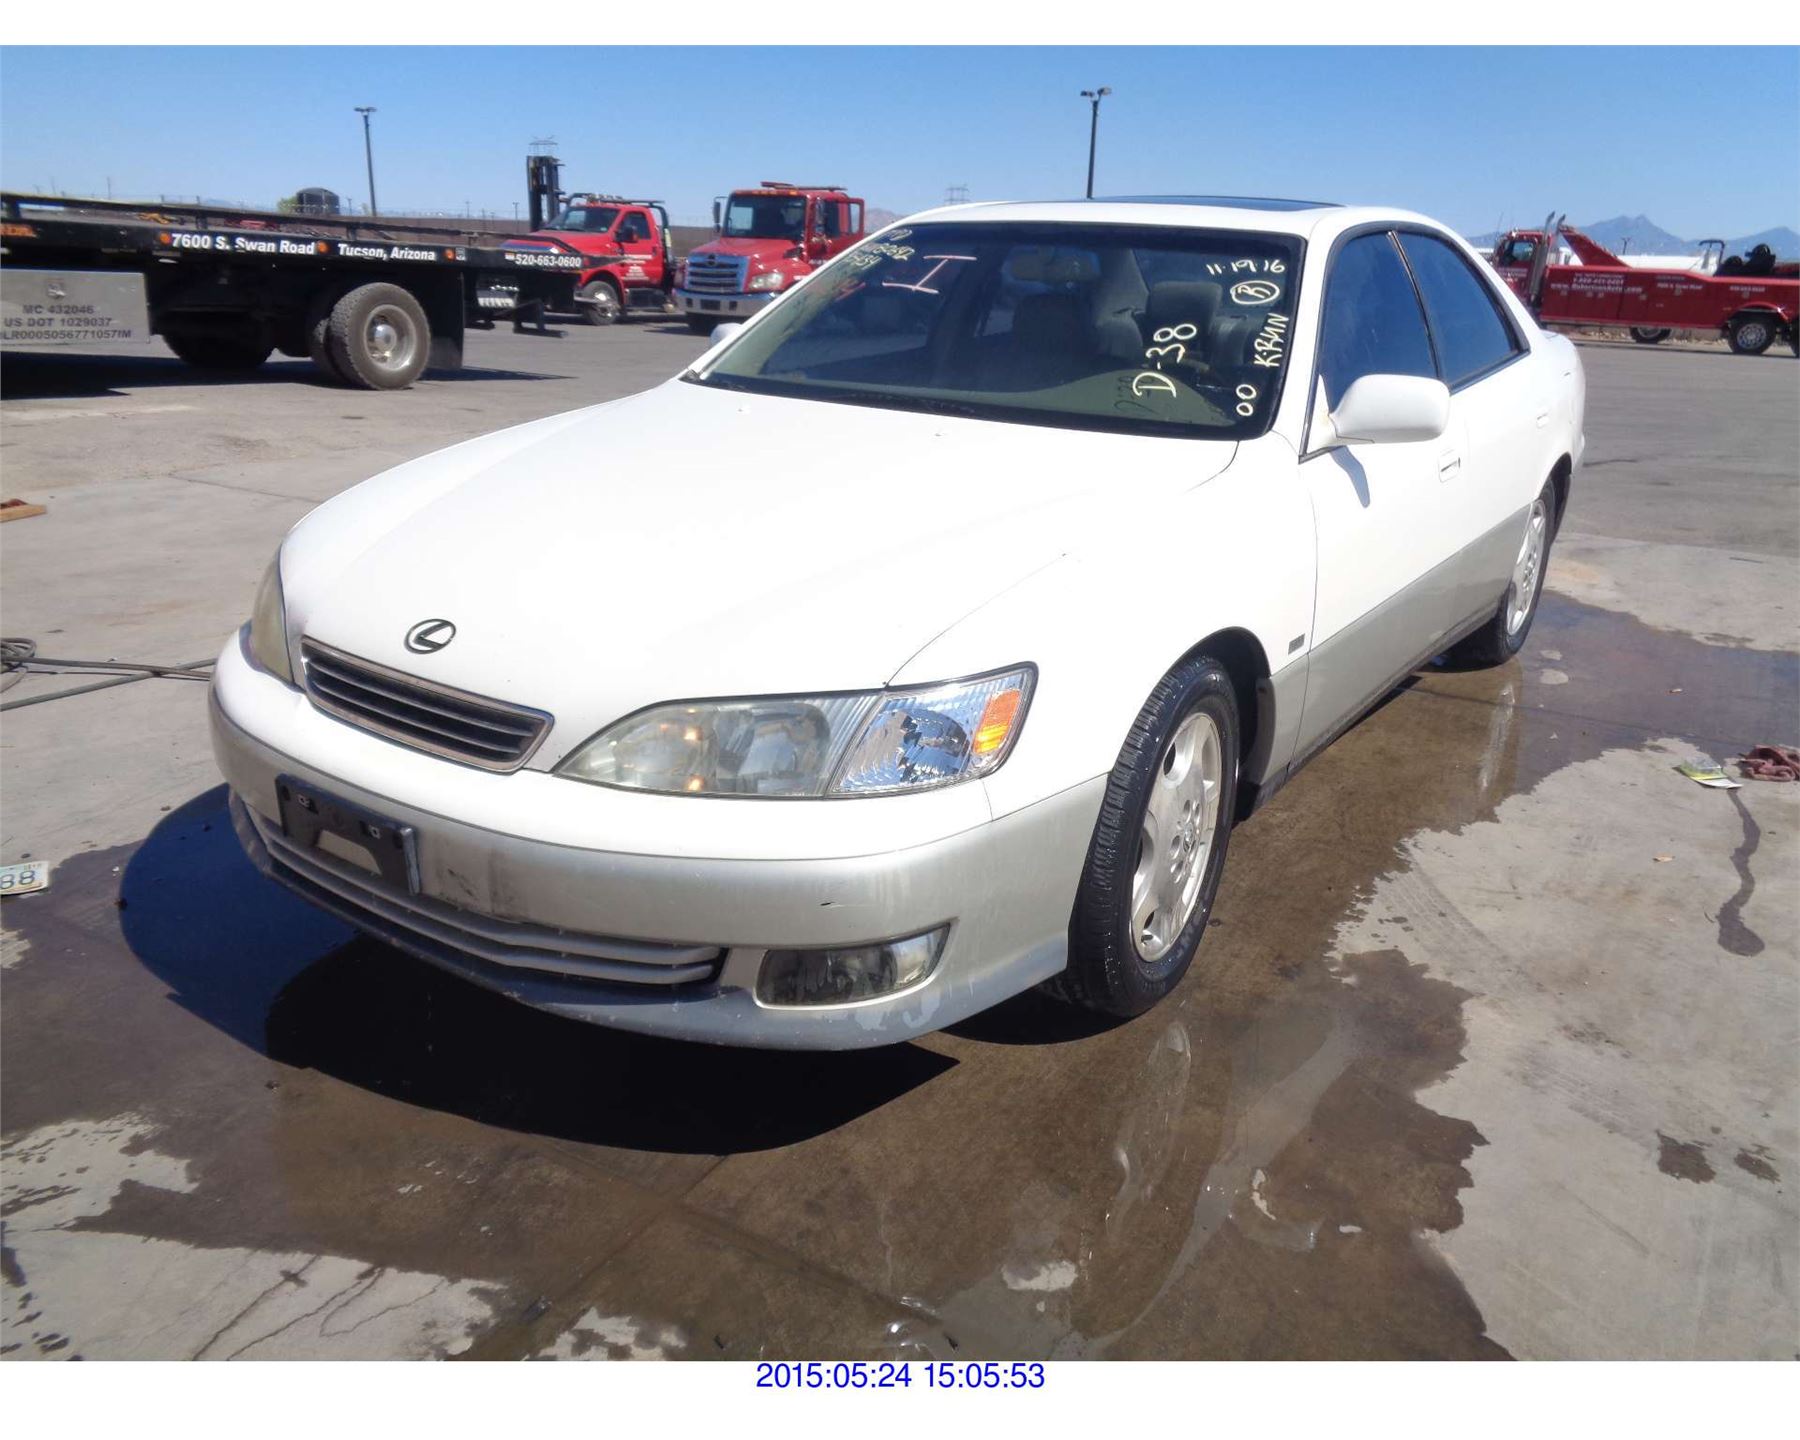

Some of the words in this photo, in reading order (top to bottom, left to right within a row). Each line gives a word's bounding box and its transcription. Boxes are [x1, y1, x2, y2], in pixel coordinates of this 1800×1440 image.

[171, 233, 211, 249] 7600
[215, 236, 230, 250] S.
[235, 237, 276, 253] Swan
[280, 240, 315, 255] Road
[338, 243, 387, 261] Tucson,
[390, 247, 437, 260] Arizona
[515, 253, 582, 267] 520-663-0600
[23, 305, 44, 314] MC
[48, 305, 95, 314] 432046
[4, 318, 22, 327] US
[27, 318, 54, 327] DOT
[60, 318, 112, 327] 1029037
